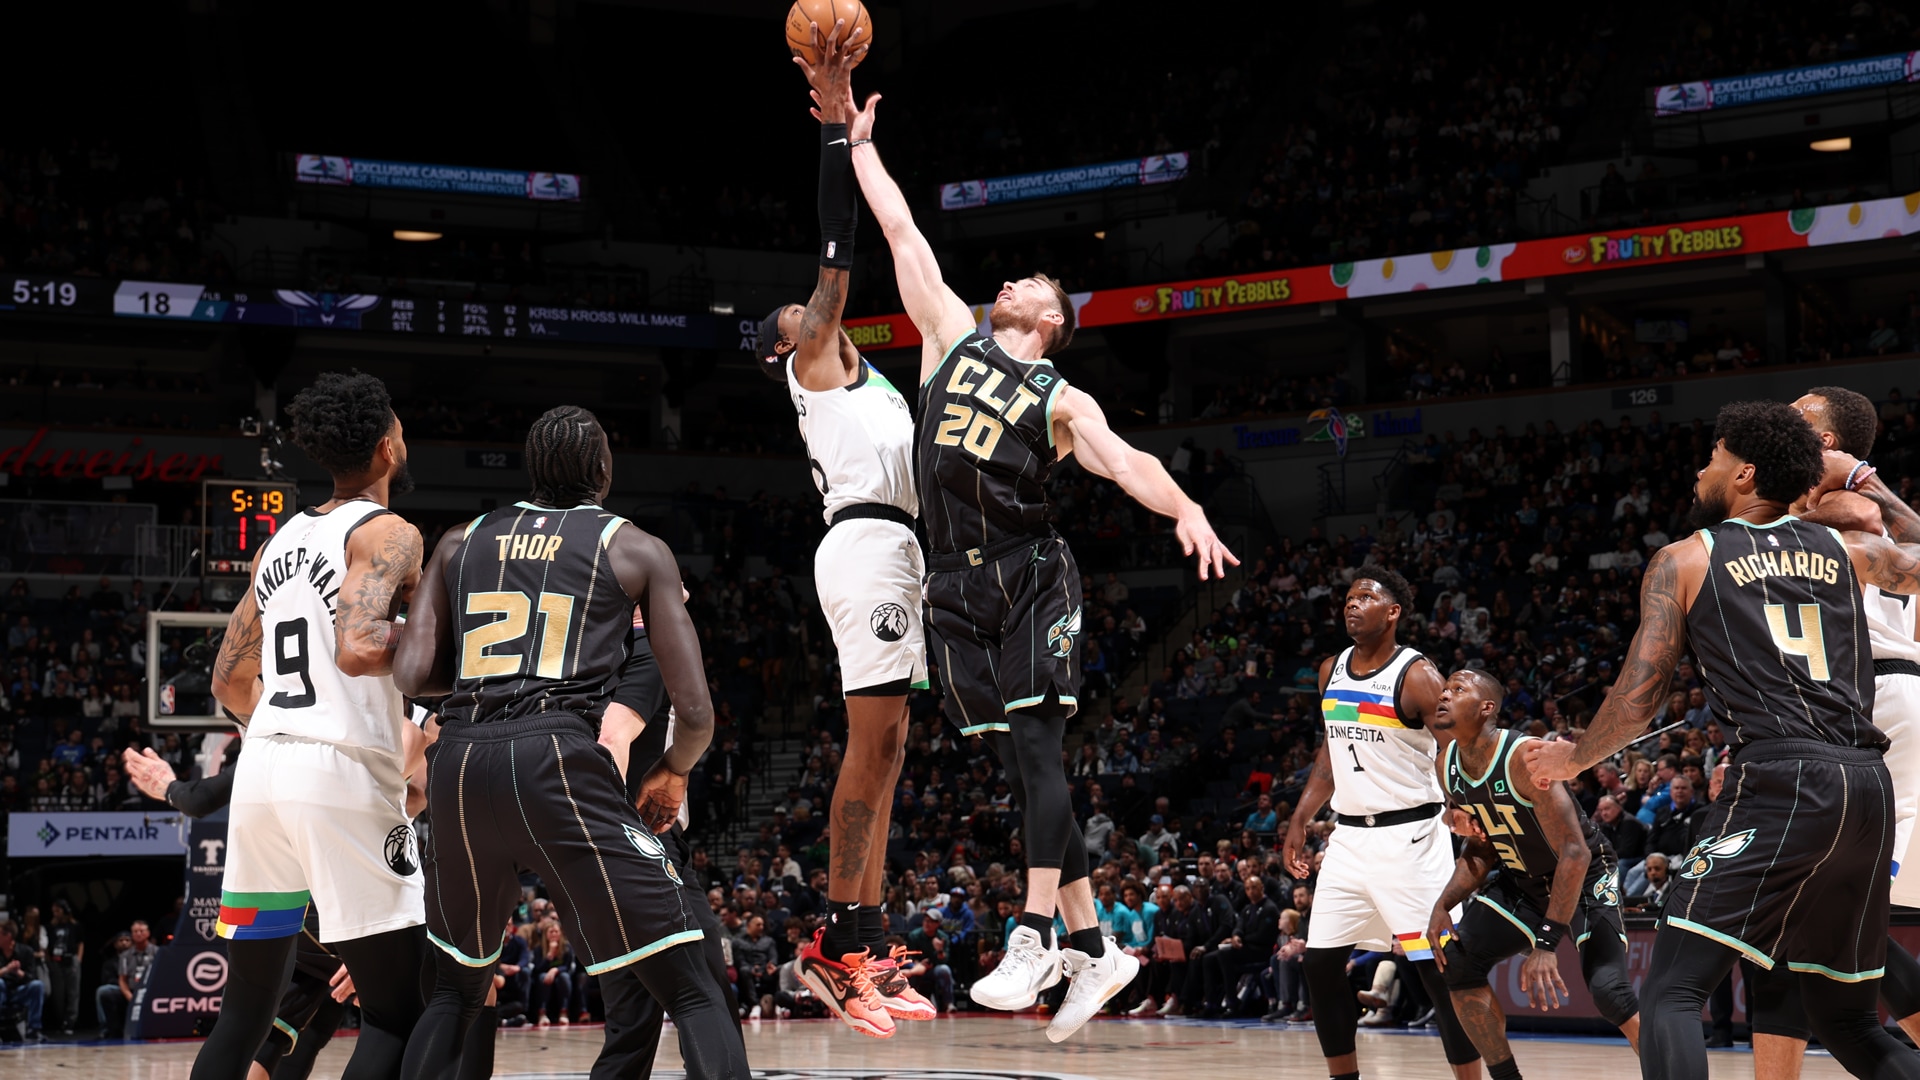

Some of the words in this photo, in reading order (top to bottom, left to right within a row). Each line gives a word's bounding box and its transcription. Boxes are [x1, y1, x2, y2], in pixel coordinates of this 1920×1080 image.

[1715, 74, 1784, 94] EXCLUSIVE
[1785, 65, 1839, 84] CASINO
[1840, 57, 1903, 77] PARTNER
[1716, 93, 1729, 105] OF
[1731, 91, 1752, 103] THE
[1754, 83, 1816, 100] MINNESOTA
[1819, 71, 1903, 91] TIMBERWOLVES
[353, 161, 421, 178] EXCLUSIVE
[421, 166, 468, 181] CASINO
[469, 170, 526, 185] PARTNER
[354, 174, 367, 184] OF
[369, 175, 389, 186] THE
[392, 176, 450, 190] MINNESOTA
[452, 181, 525, 196] TIMBERWOLVES
[987, 174, 1045, 192] EXCLUSIVE
[1045, 169, 1087, 185] CASINO
[1088, 162, 1139, 178] PARTNER
[988, 190, 1000, 201] OF
[1002, 189, 1018, 199] THE
[1019, 184, 1071, 198] MINNESOTA
[1667, 226, 1743, 255] PEBBLES
[12, 279, 77, 307] 5:19
[139, 292, 170, 315] 18
[1225, 278, 1291, 305] PEBBLES
[205, 305, 216, 318] 4
[236, 306, 246, 320] 7
[391, 299, 414, 311] REB
[437, 300, 445, 310] 7
[391, 311, 414, 321] AST
[463, 303, 488, 315] FG%
[528, 306, 569, 321] KRISS
[570, 309, 616, 324] KROSS
[617, 312, 648, 326] WILL
[650, 314, 688, 328] MAKE
[392, 321, 414, 332] STL
[463, 315, 488, 325] FT%
[945, 355, 1042, 427] CLT
[1627, 388, 1657, 406] 126
[934, 402, 1005, 462] 20
[1234, 424, 1300, 449] Treasure
[1373, 407, 1422, 437] Island
[480, 453, 507, 468] 122
[231, 488, 285, 514] 5:19
[239, 514, 277, 551] 17
[495, 533, 563, 562] THOR
[1724, 550, 1840, 588] RICHARDS
[460, 591, 575, 680] 21
[1763, 602, 1831, 681] 4
[269, 617, 317, 709] 9
[1326, 725, 1386, 743] INNESOTA
[1347, 743, 1366, 772] 1
[66, 826, 159, 842] PENTAIR
[189, 907, 220, 918] CLIN
[193, 897, 221, 907] MAY
